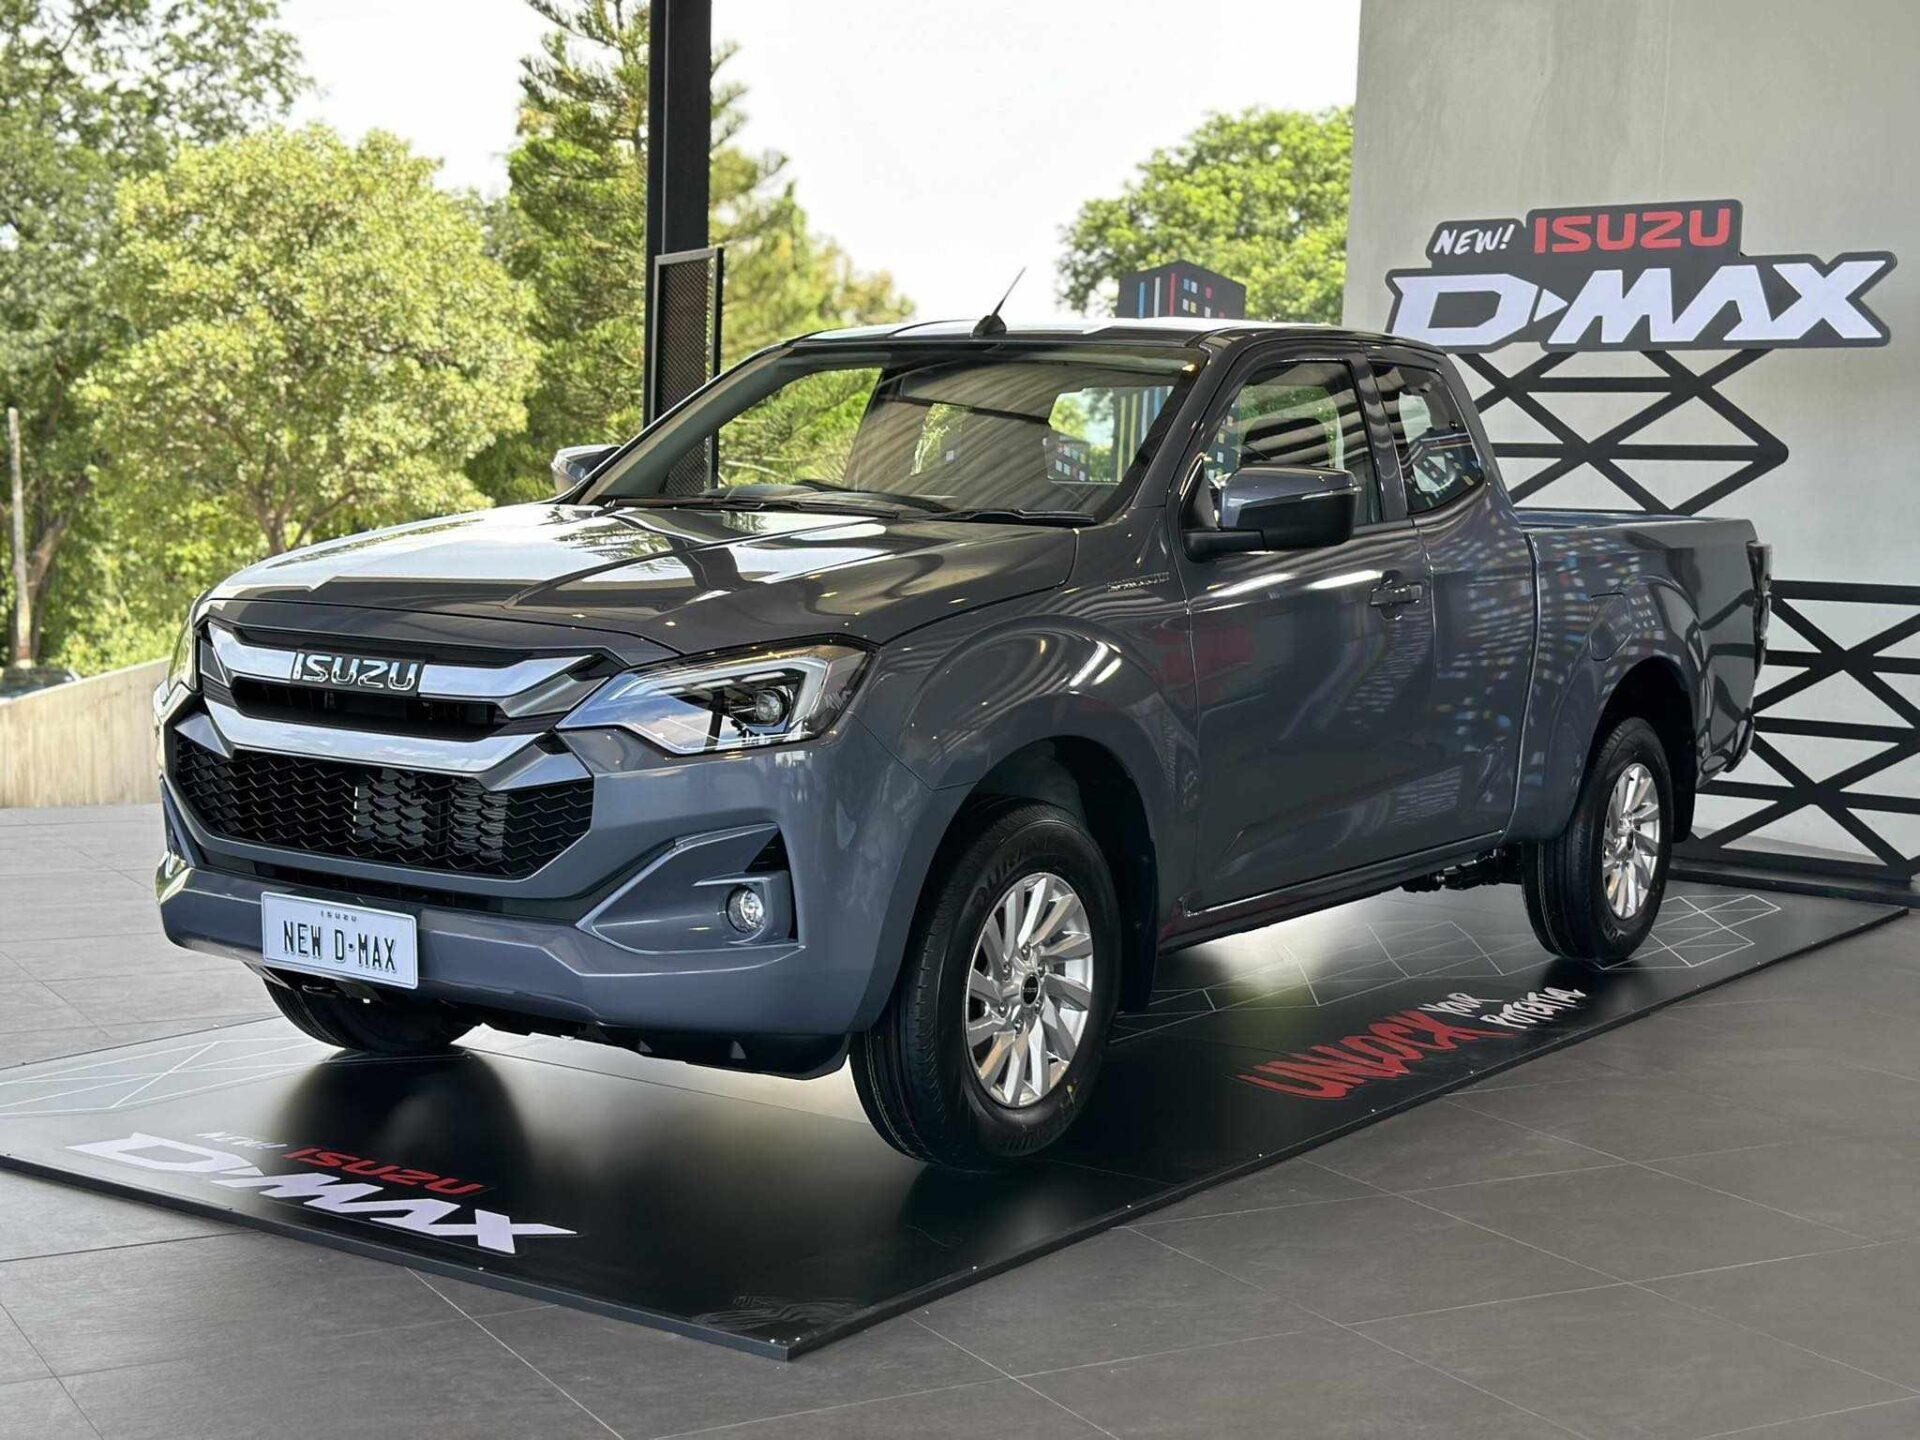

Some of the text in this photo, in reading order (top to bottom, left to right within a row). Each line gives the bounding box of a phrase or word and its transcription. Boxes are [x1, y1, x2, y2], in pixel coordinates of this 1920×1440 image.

[1432, 207, 1731, 256] NEW! ISUZU
[1391, 259, 1887, 347] D-MAX
[292, 653, 418, 691] ISUZU
[320, 910, 357, 923] ISUZU
[283, 920, 396, 971] NEW D-MAX
[1236, 1010, 1518, 1098] UNLOCK
[65, 1132, 578, 1254] D-MAX
[282, 1146, 484, 1195] ISUZU
